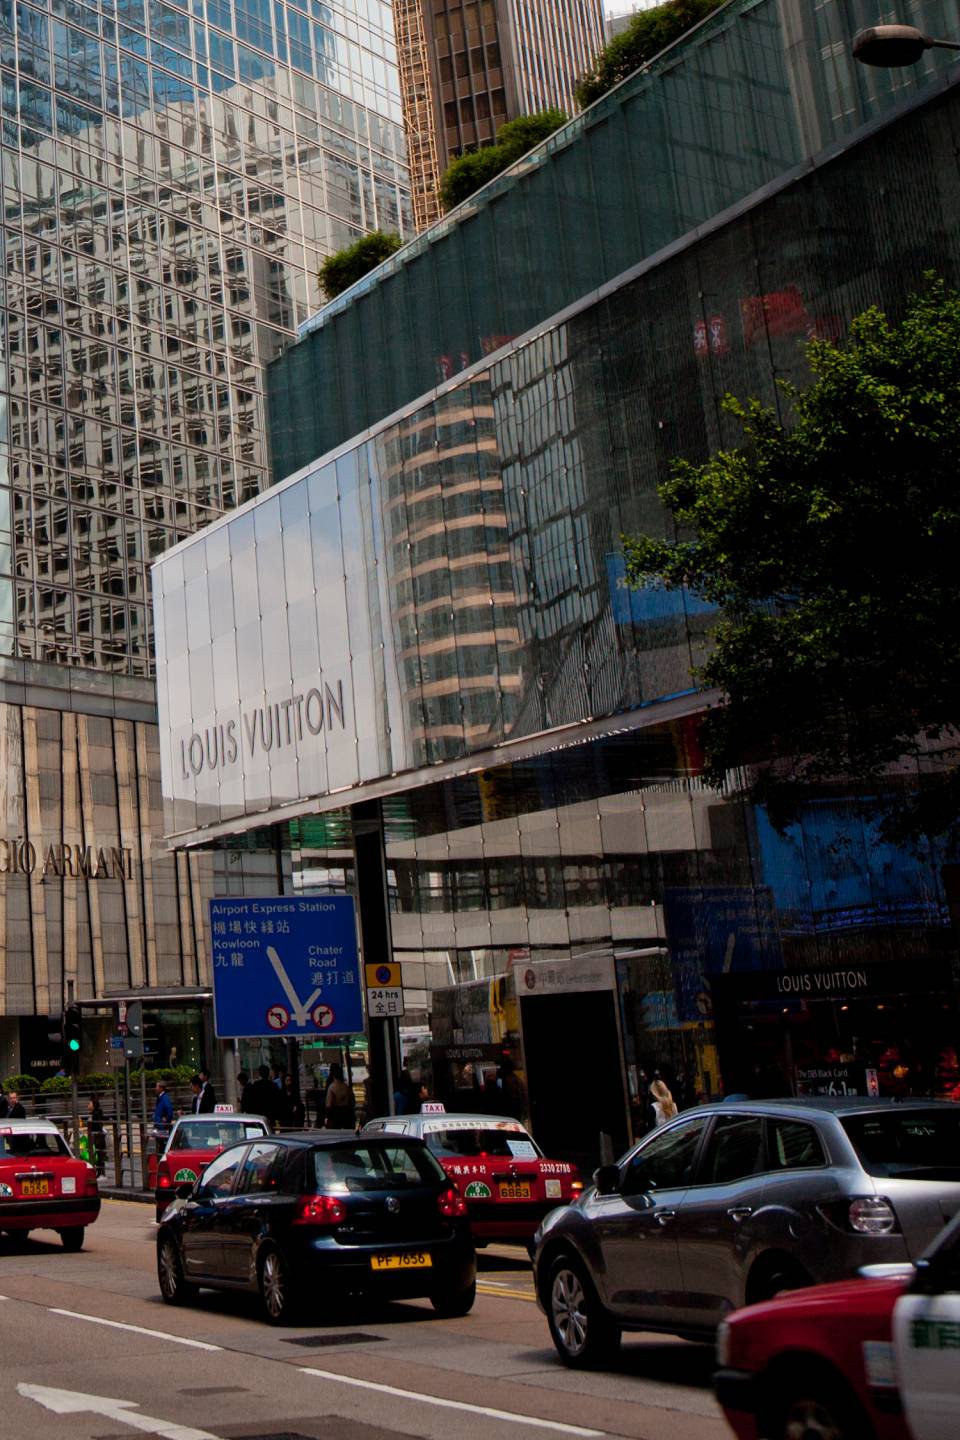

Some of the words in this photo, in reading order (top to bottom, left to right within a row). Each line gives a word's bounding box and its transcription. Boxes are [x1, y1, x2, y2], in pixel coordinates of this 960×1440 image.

[180, 719, 239, 781] LOUIS
[244, 679, 345, 759] VUITTON
[42, 842, 133, 881] ARMANI
[212, 904, 249, 918] Airport
[253, 903, 296, 917] Express
[299, 901, 336, 913] Station
[214, 939, 260, 950] Kowloon
[308, 945, 343, 956] Chater
[216, 951, 245, 967] 九龍
[309, 957, 337, 968] Road
[311, 969, 356, 985] 遮打道
[777, 974, 812, 992] LOUIS
[813, 969, 868, 990] VUITTON
[371, 990, 384, 1000] 24
[385, 989, 399, 1000] hrs
[375, 1001, 398, 1014] 全日
[216, 1104, 233, 1112] TAXI
[424, 1104, 443, 1112] TAXI
[377, 1255, 393, 1267] PF
